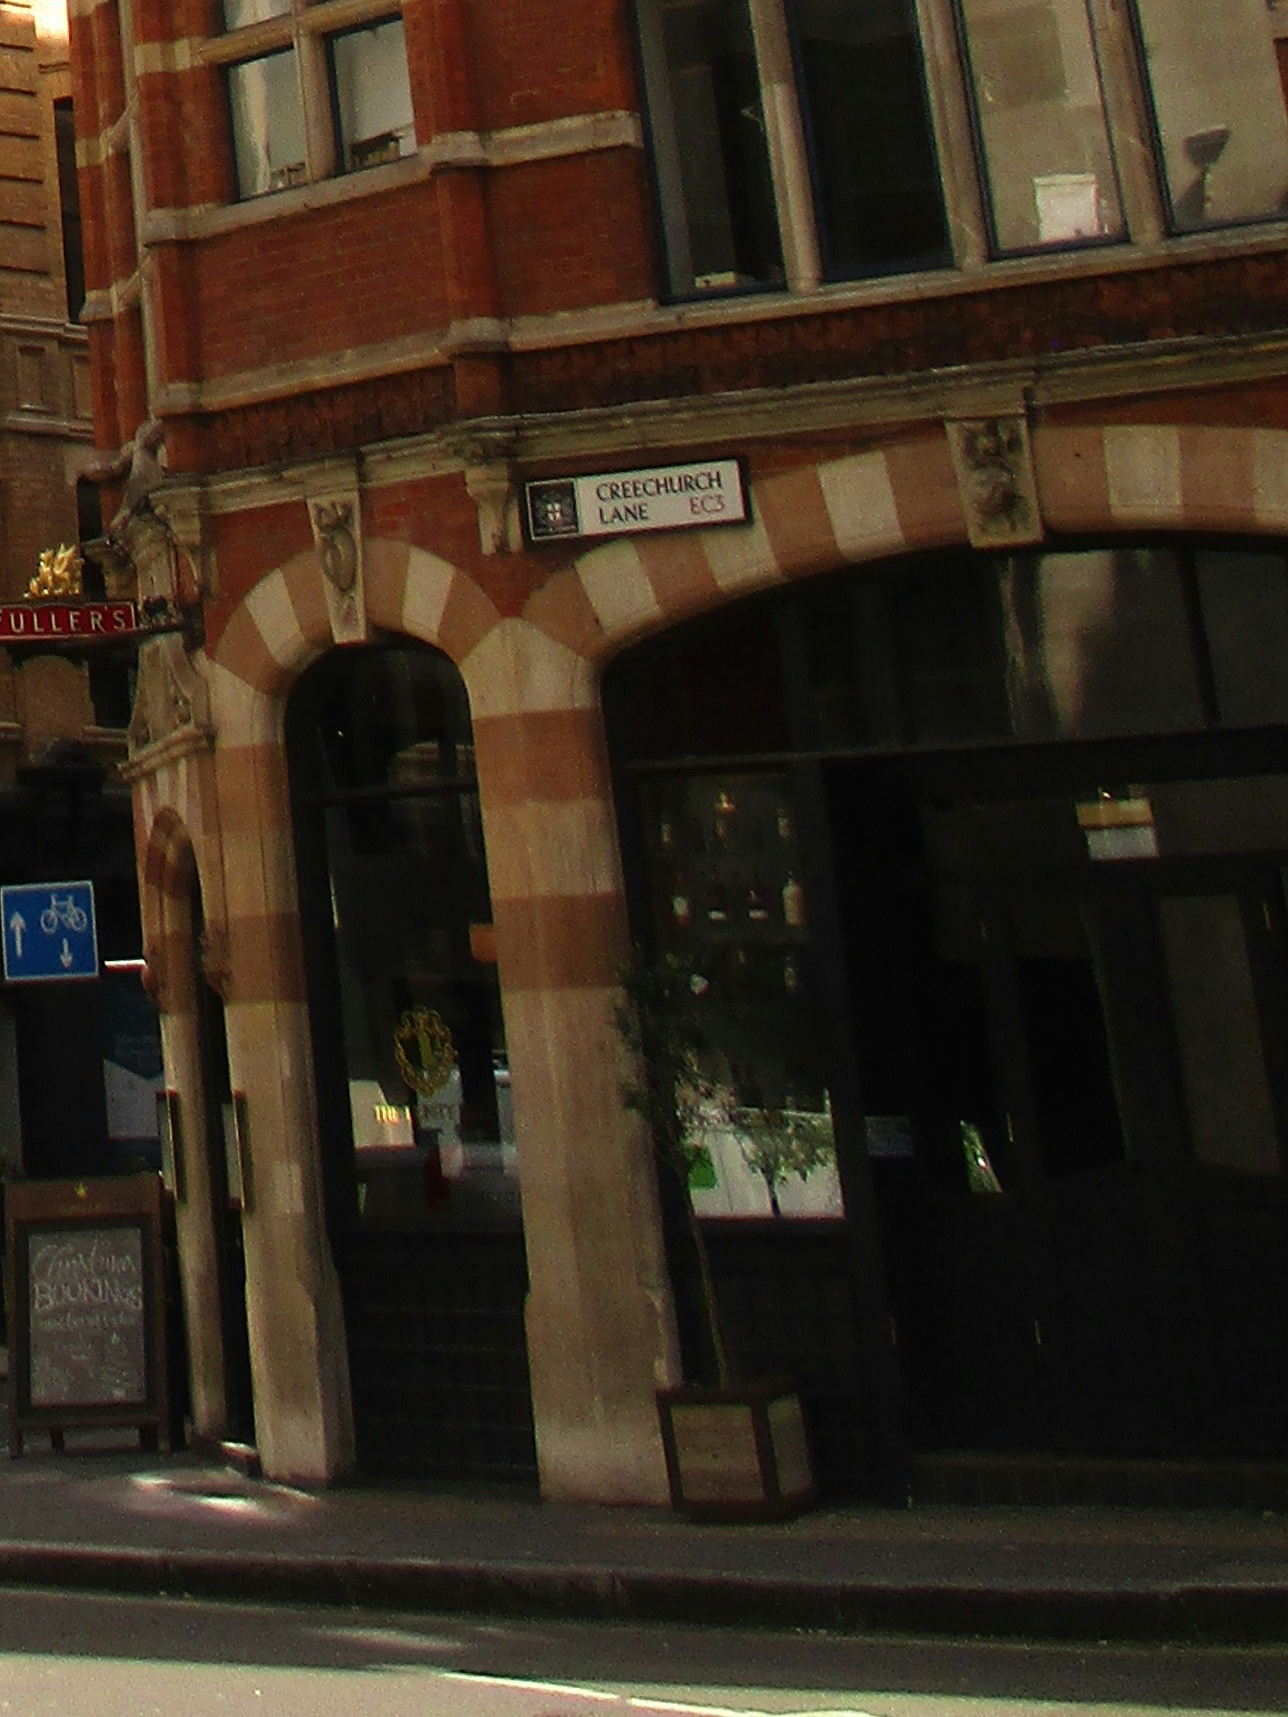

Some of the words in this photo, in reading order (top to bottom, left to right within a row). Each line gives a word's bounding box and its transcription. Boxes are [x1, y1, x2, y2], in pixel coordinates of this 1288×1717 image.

[596, 470, 723, 502] CREECHURCH
[598, 502, 650, 525] LANE
[689, 493, 726, 515] EC3
